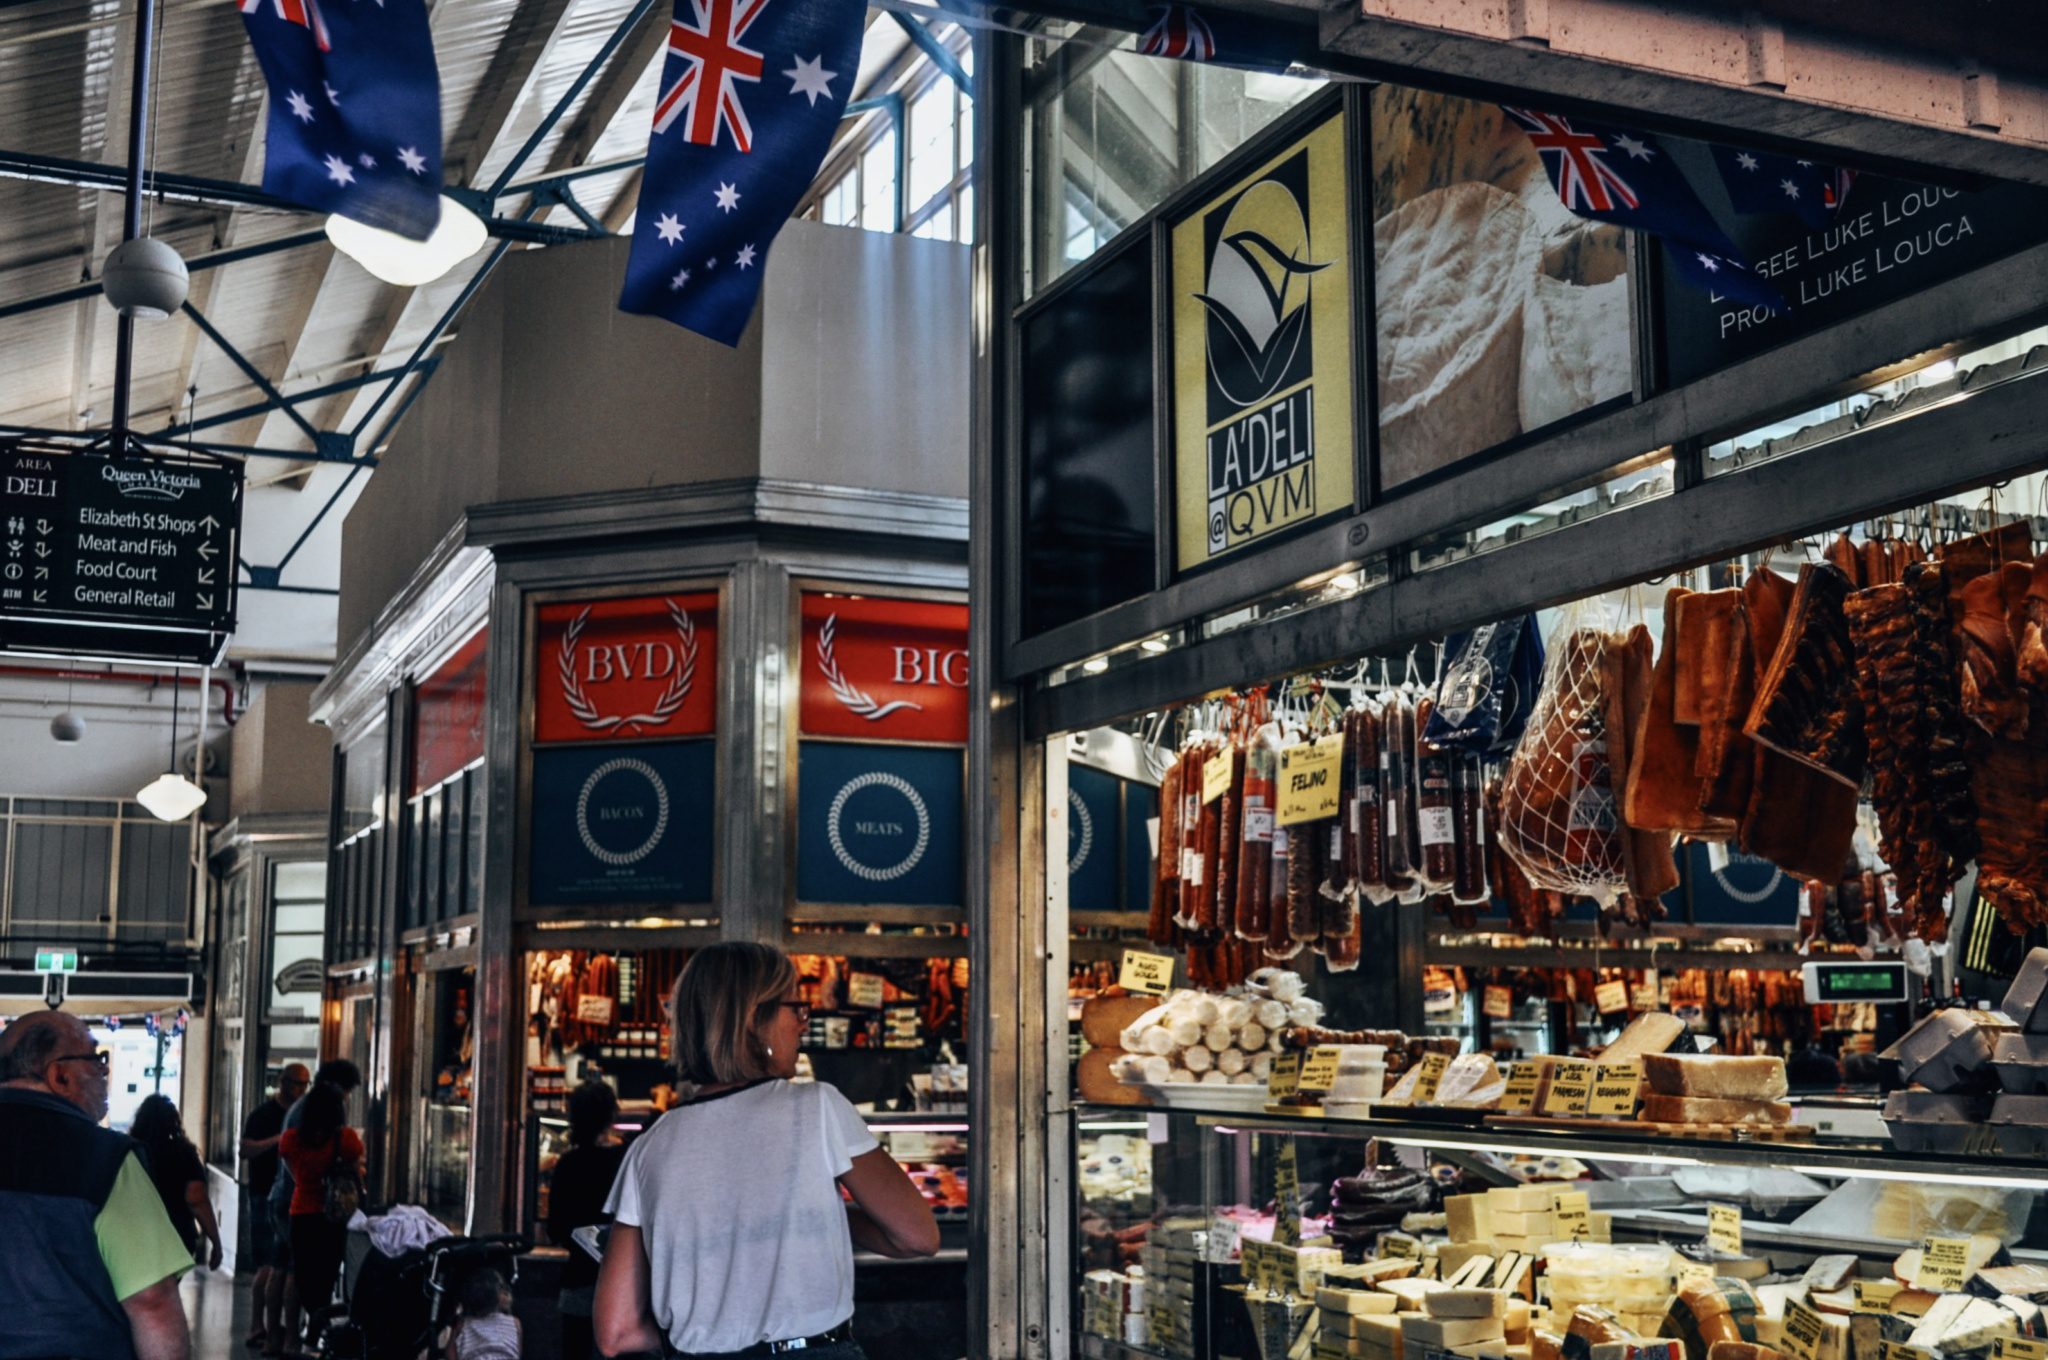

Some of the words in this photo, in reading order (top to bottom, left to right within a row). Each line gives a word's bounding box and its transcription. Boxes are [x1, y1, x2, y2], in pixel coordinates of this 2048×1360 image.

[1806, 211, 1875, 260] LUKE
[1800, 257, 1868, 305] LUKE
[1875, 215, 1975, 274] LOUCA
[15, 458, 52, 472] AREA
[101, 464, 147, 483] Queen
[149, 468, 201, 489] Victoria
[6, 476, 58, 498] DELI
[79, 507, 141, 529] Elizabeth
[142, 514, 156, 530] St
[157, 516, 196, 536] Shops
[78, 534, 117, 552] Meat
[119, 537, 148, 555] and
[150, 539, 177, 557] Fish
[76, 559, 114, 578] Food
[116, 562, 157, 582] Court
[3, 588, 22, 600] ATM
[74, 585, 132, 605] General
[134, 589, 175, 609] Retail
[584, 641, 676, 683] BVD
[891, 646, 969, 687] BIG
[600, 805, 645, 821] BACON
[855, 821, 903, 837] MEATS
